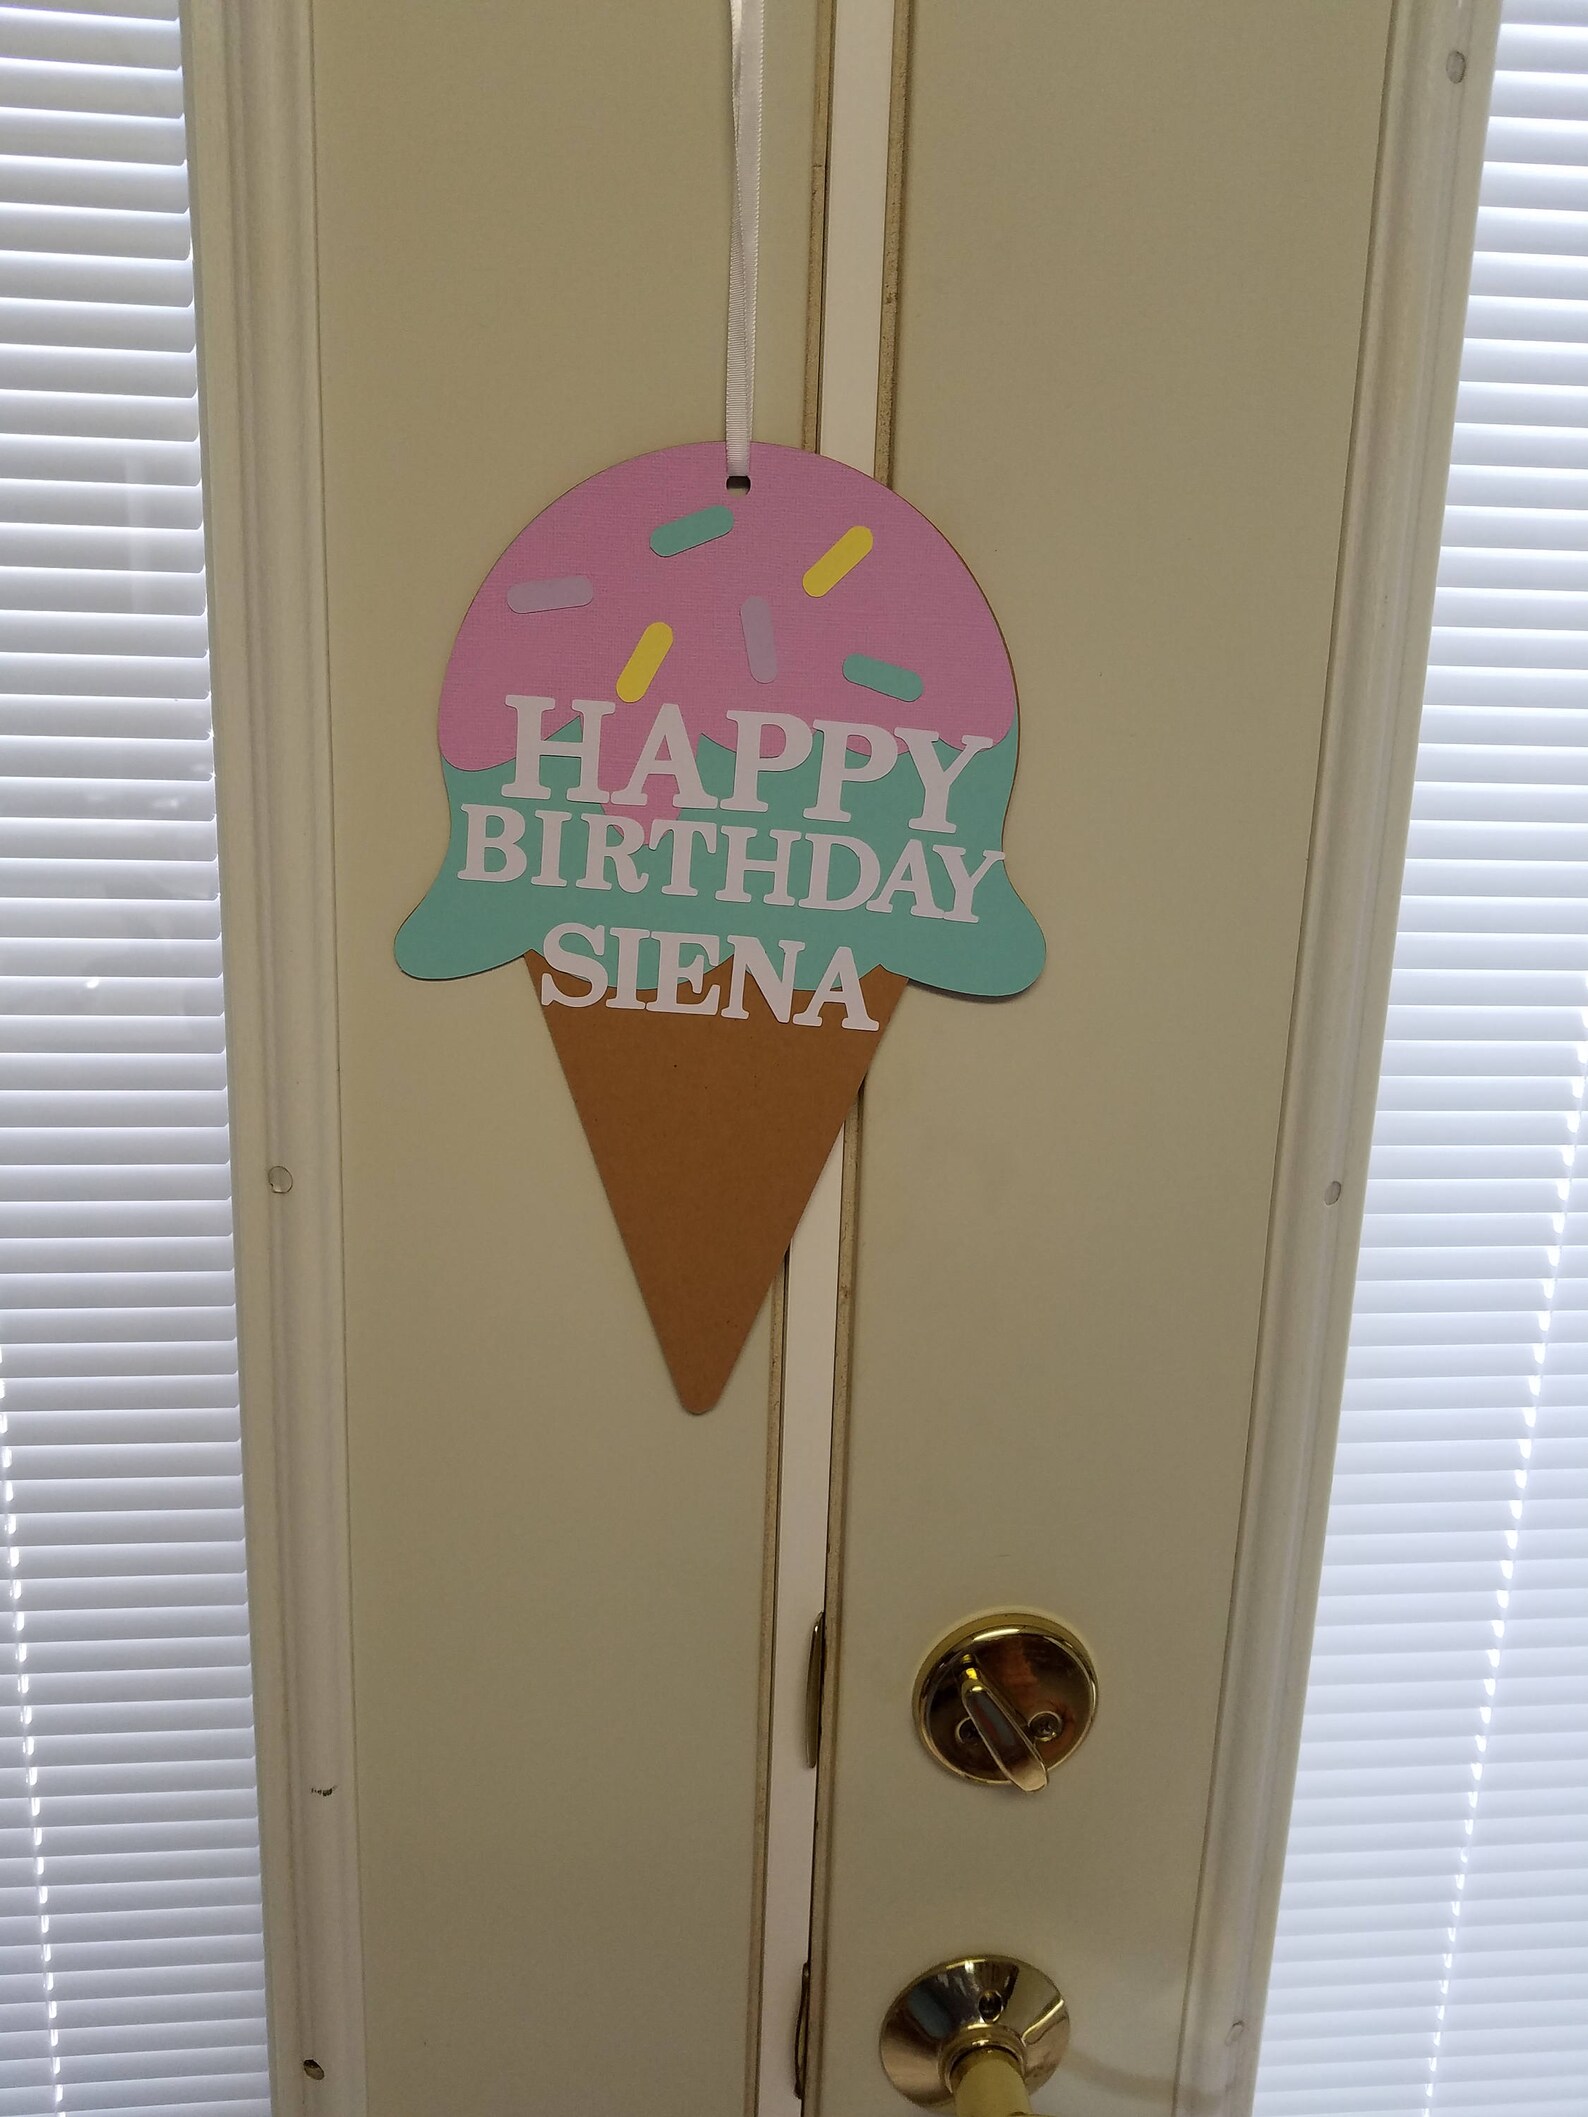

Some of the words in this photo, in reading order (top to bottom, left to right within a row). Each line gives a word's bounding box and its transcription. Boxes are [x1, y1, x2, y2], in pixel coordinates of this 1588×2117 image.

[501, 694, 993, 834] HAPPY
[457, 803, 1005, 923] BIRTHDAY
[541, 922, 880, 1032] SIENA
